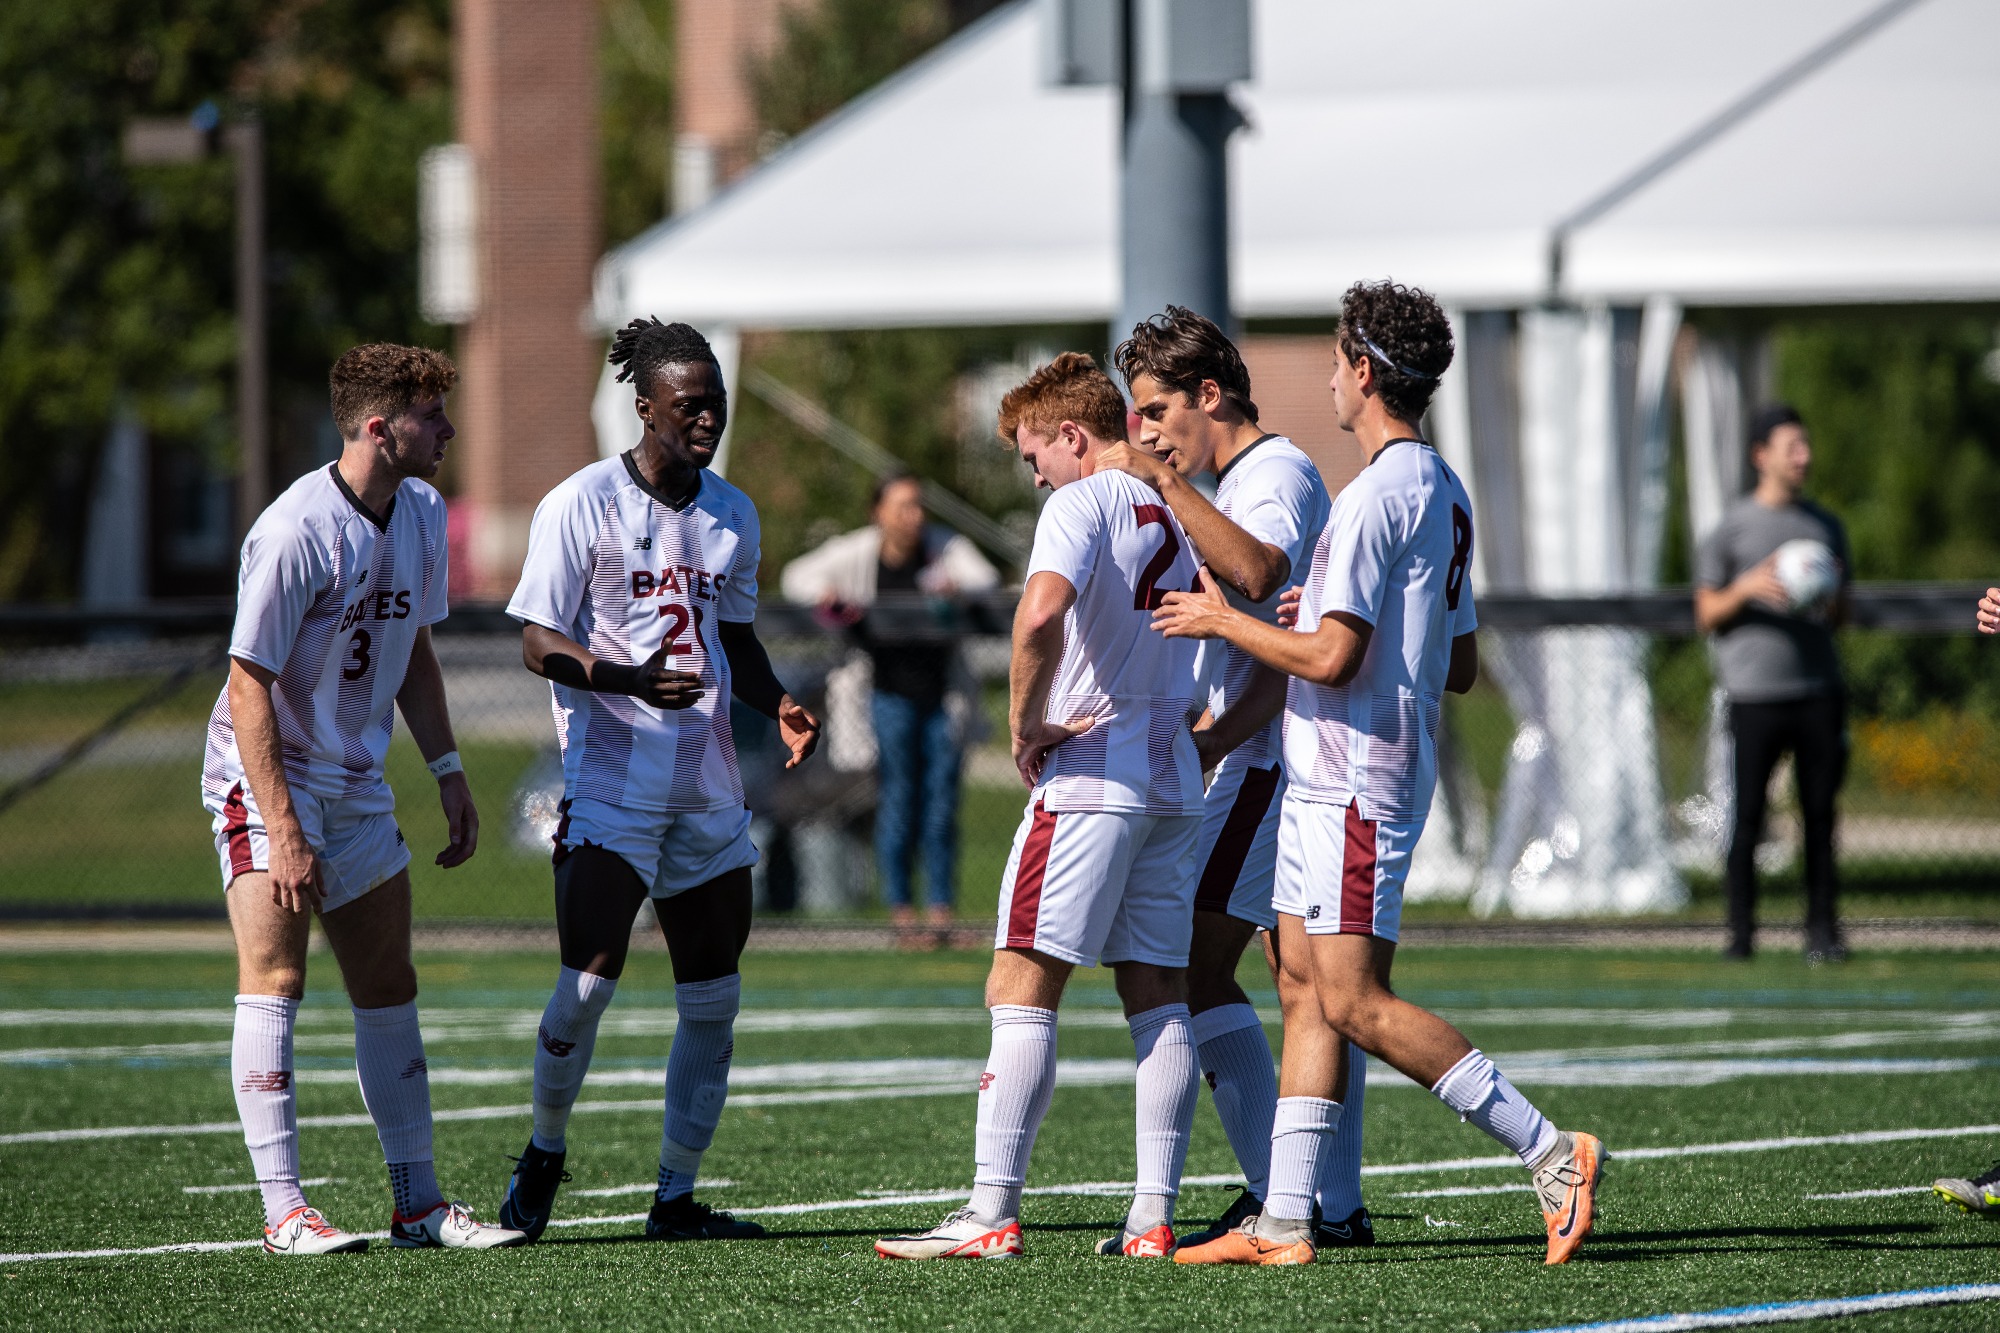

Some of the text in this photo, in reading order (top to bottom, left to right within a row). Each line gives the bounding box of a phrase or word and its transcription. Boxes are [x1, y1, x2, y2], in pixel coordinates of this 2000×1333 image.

[631, 565, 728, 600] BATES
[1445, 502, 1472, 612] 8
[342, 628, 372, 682] 3
